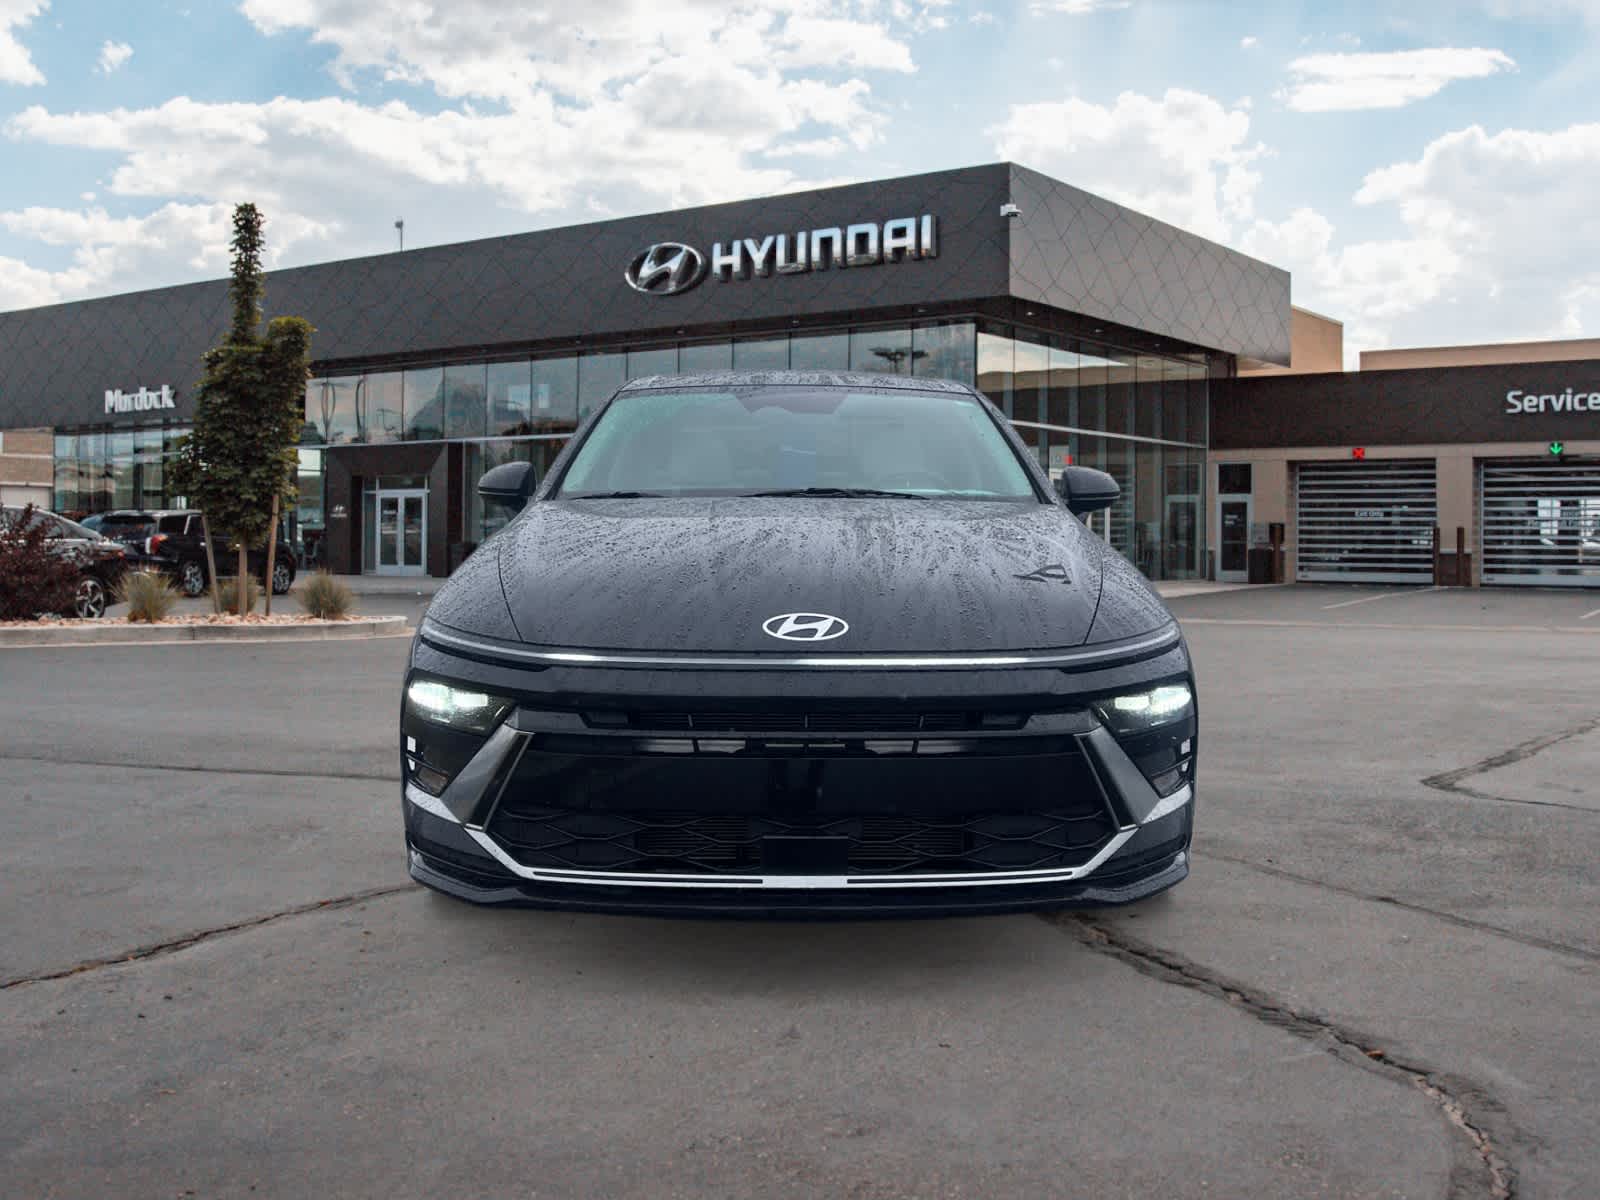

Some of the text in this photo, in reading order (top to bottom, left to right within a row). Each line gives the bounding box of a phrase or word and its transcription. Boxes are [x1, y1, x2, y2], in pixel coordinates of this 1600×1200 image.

[712, 214, 937, 282] HYUNDAI
[104, 384, 176, 414] Murdock
[1505, 387, 1600, 413] Service
